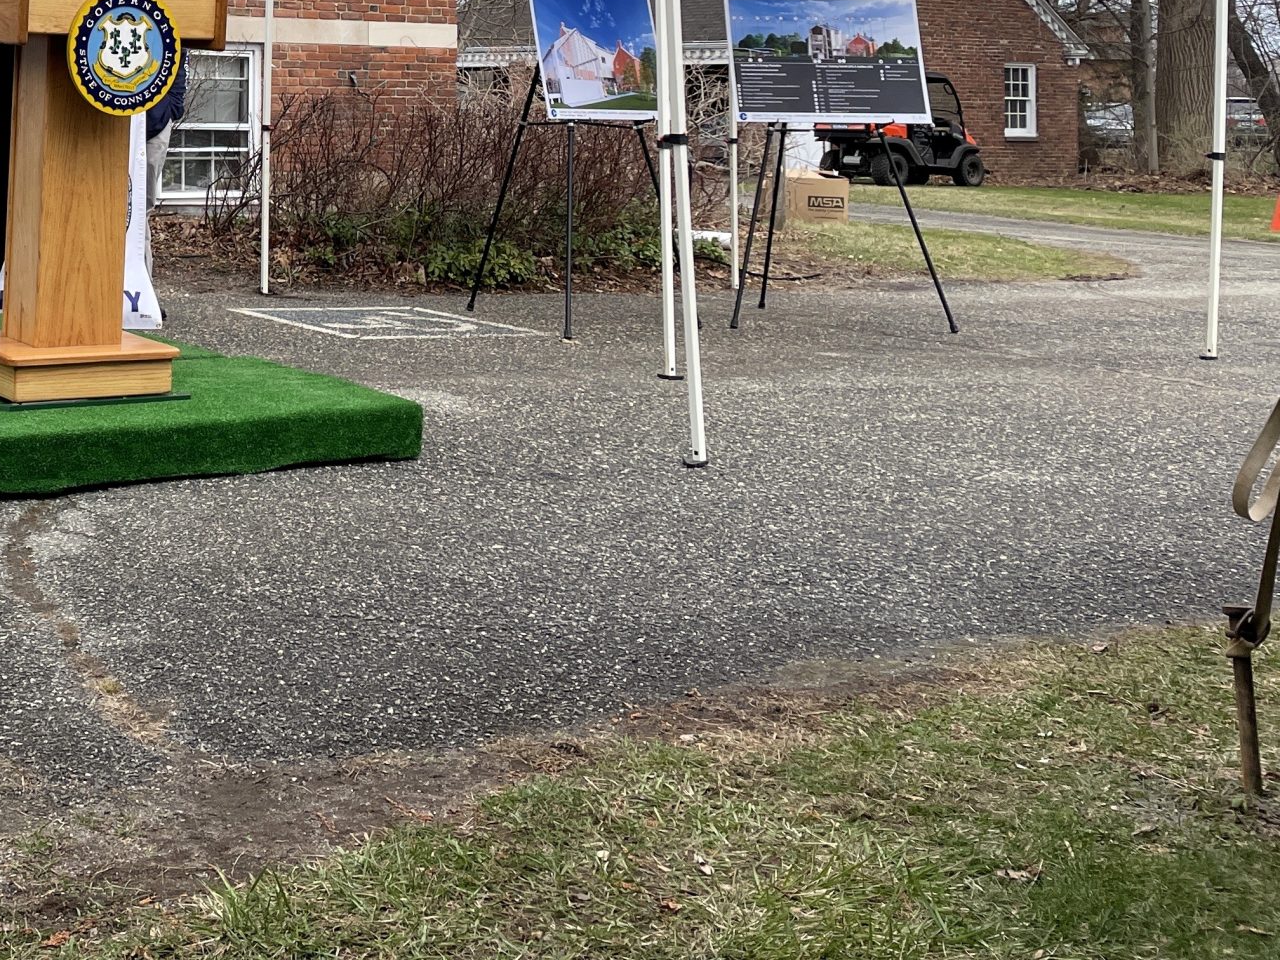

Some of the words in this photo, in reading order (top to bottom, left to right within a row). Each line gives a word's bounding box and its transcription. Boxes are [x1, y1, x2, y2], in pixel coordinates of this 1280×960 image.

[79, 48, 98, 90] STATE
[98, 90, 112, 102] OF
[114, 50, 173, 105] CONNECTICUT
[810, 197, 844, 208] MSA
